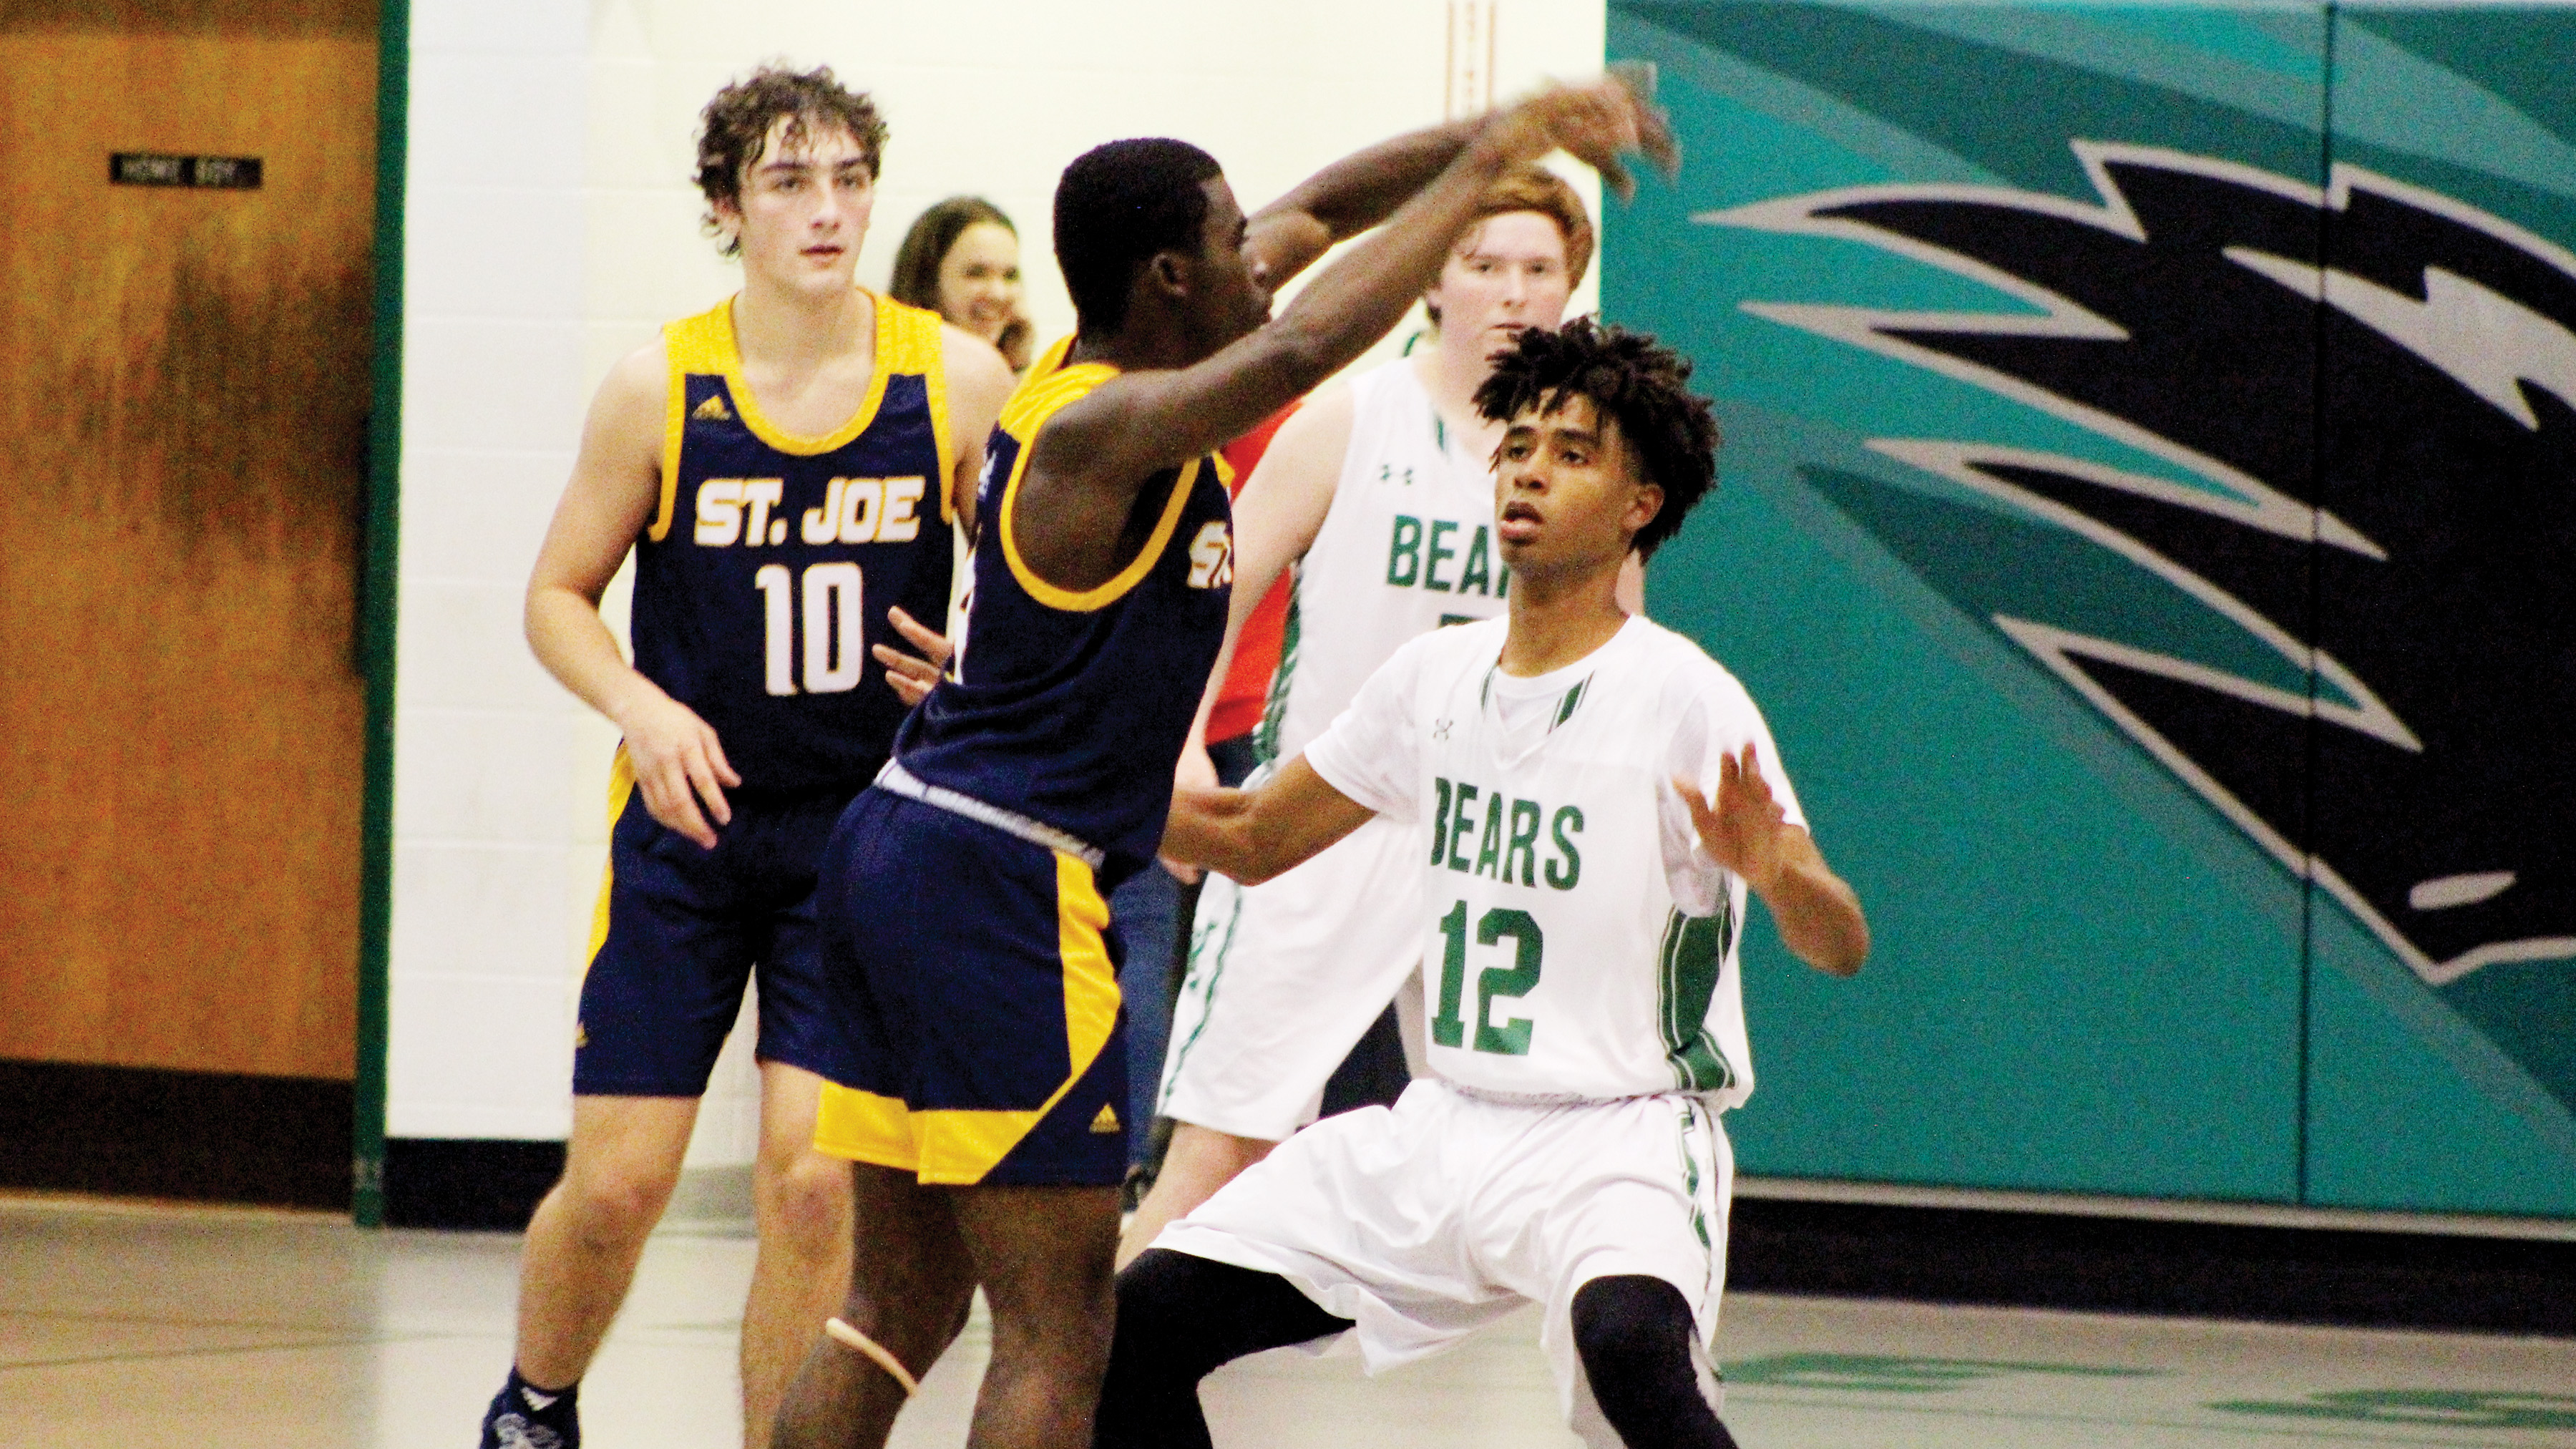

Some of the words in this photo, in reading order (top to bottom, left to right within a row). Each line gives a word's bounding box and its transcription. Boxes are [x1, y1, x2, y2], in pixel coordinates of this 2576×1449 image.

[694, 477, 788, 547] ST.
[801, 475, 925, 545] JOE
[755, 562, 863, 696] 10
[1431, 899, 1543, 1055] 12
